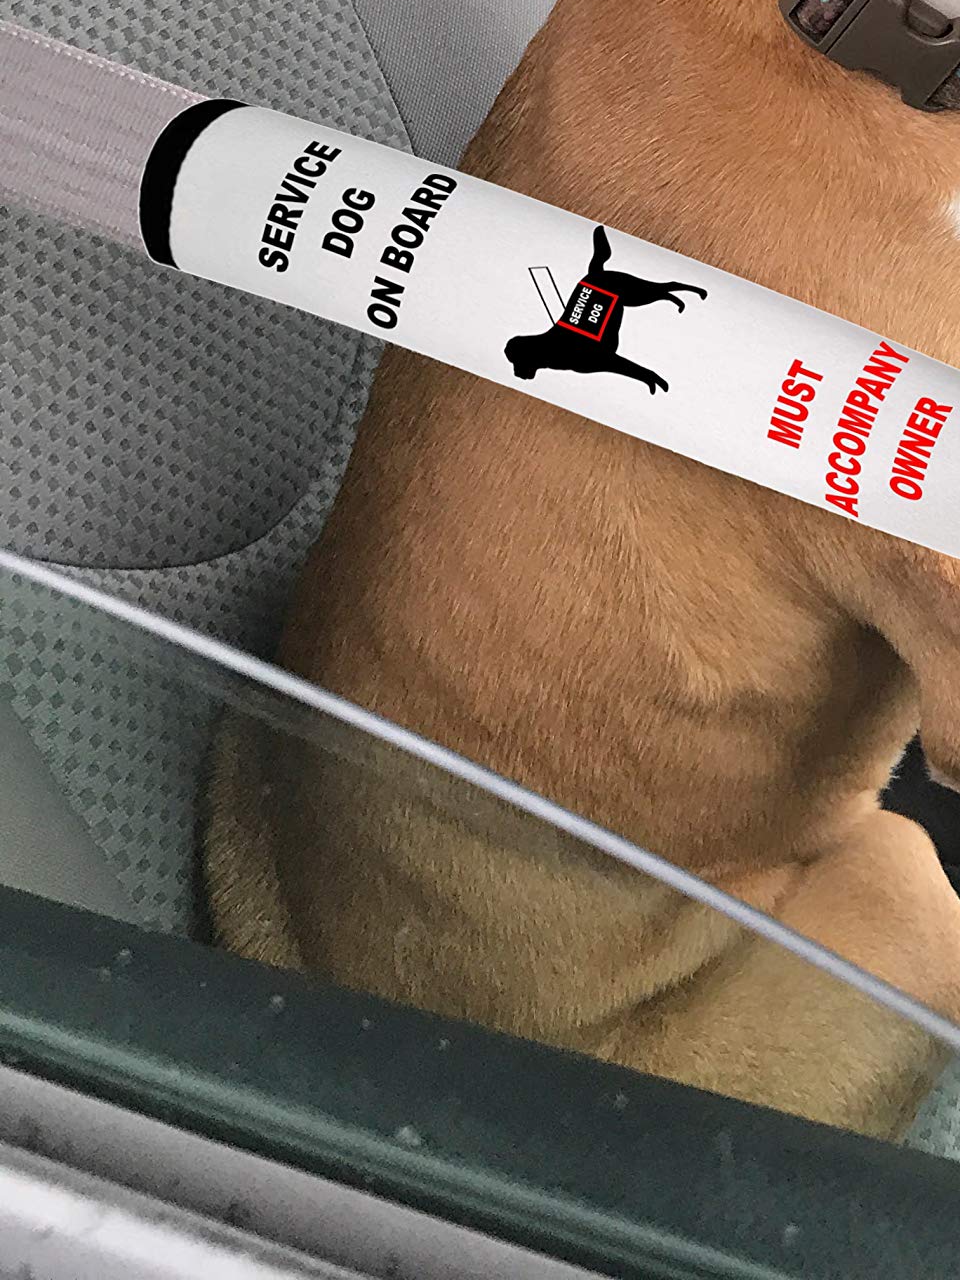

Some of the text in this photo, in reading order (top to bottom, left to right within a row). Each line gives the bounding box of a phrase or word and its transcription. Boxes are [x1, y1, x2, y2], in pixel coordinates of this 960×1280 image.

[258, 140, 343, 273] SERVICE
[321, 187, 376, 259] DOG
[366, 173, 458, 330] ON BOARD
[569, 286, 593, 325] SERVICE
[587, 303, 604, 324] DOG
[767, 358, 824, 449] MUST
[824, 340, 910, 518] ACCOMPANY
[888, 396, 953, 501] OWNER
